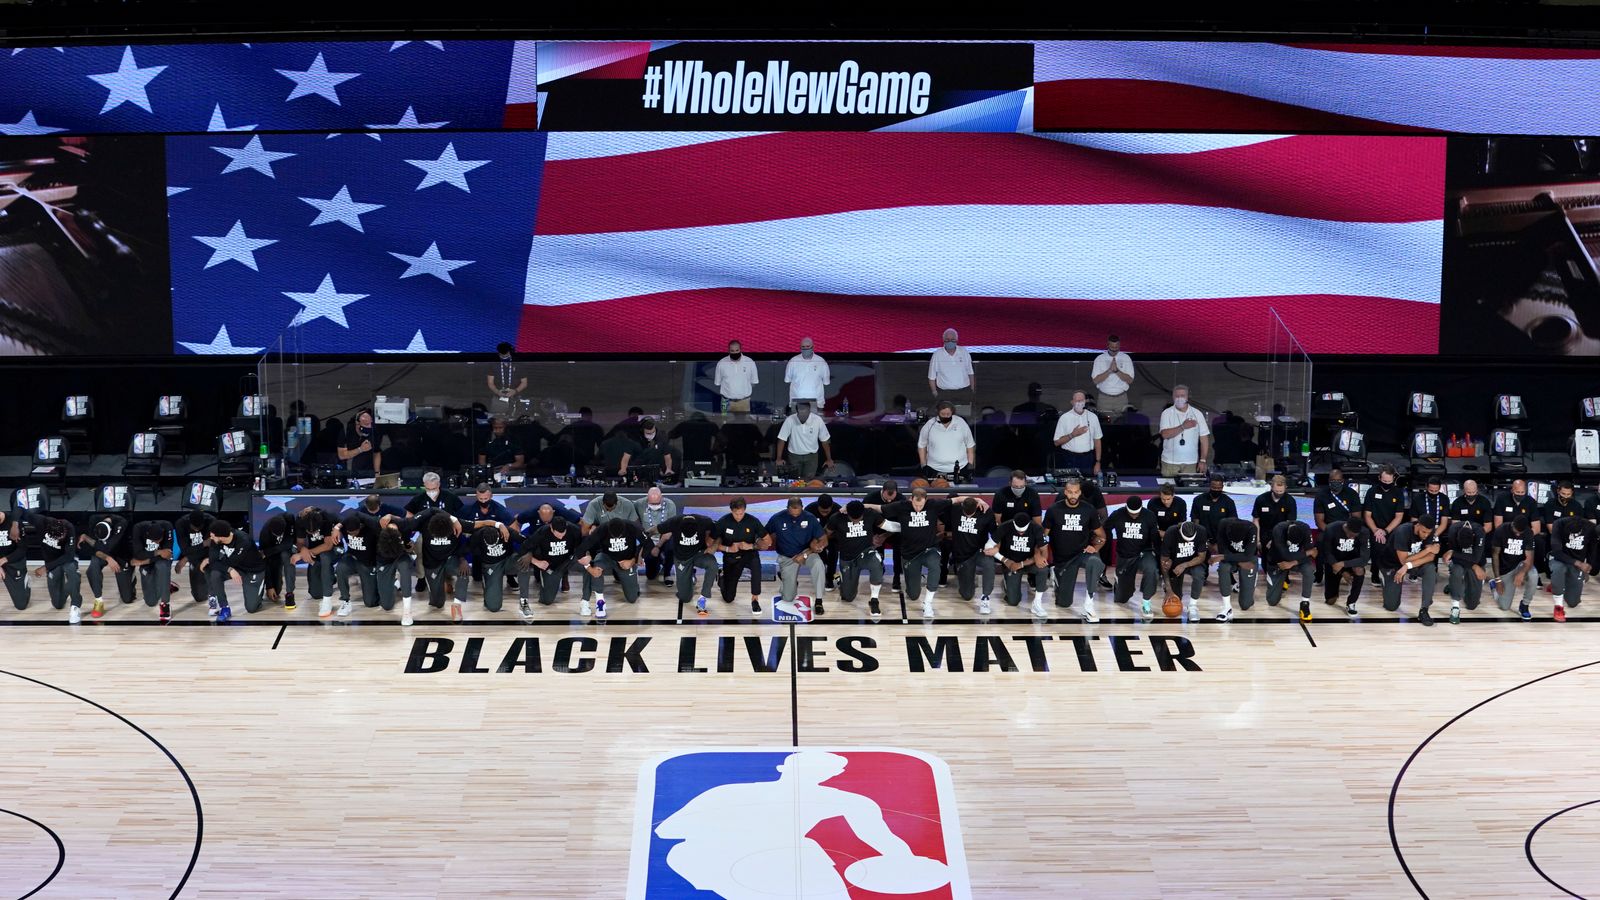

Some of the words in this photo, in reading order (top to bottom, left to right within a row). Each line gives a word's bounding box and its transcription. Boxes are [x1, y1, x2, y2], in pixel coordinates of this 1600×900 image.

[642, 60, 931, 114] #WholeNewGame
[404, 637, 653, 673] BLACK
[677, 636, 879, 673] LIVES
[905, 636, 1203, 672] MATTER
